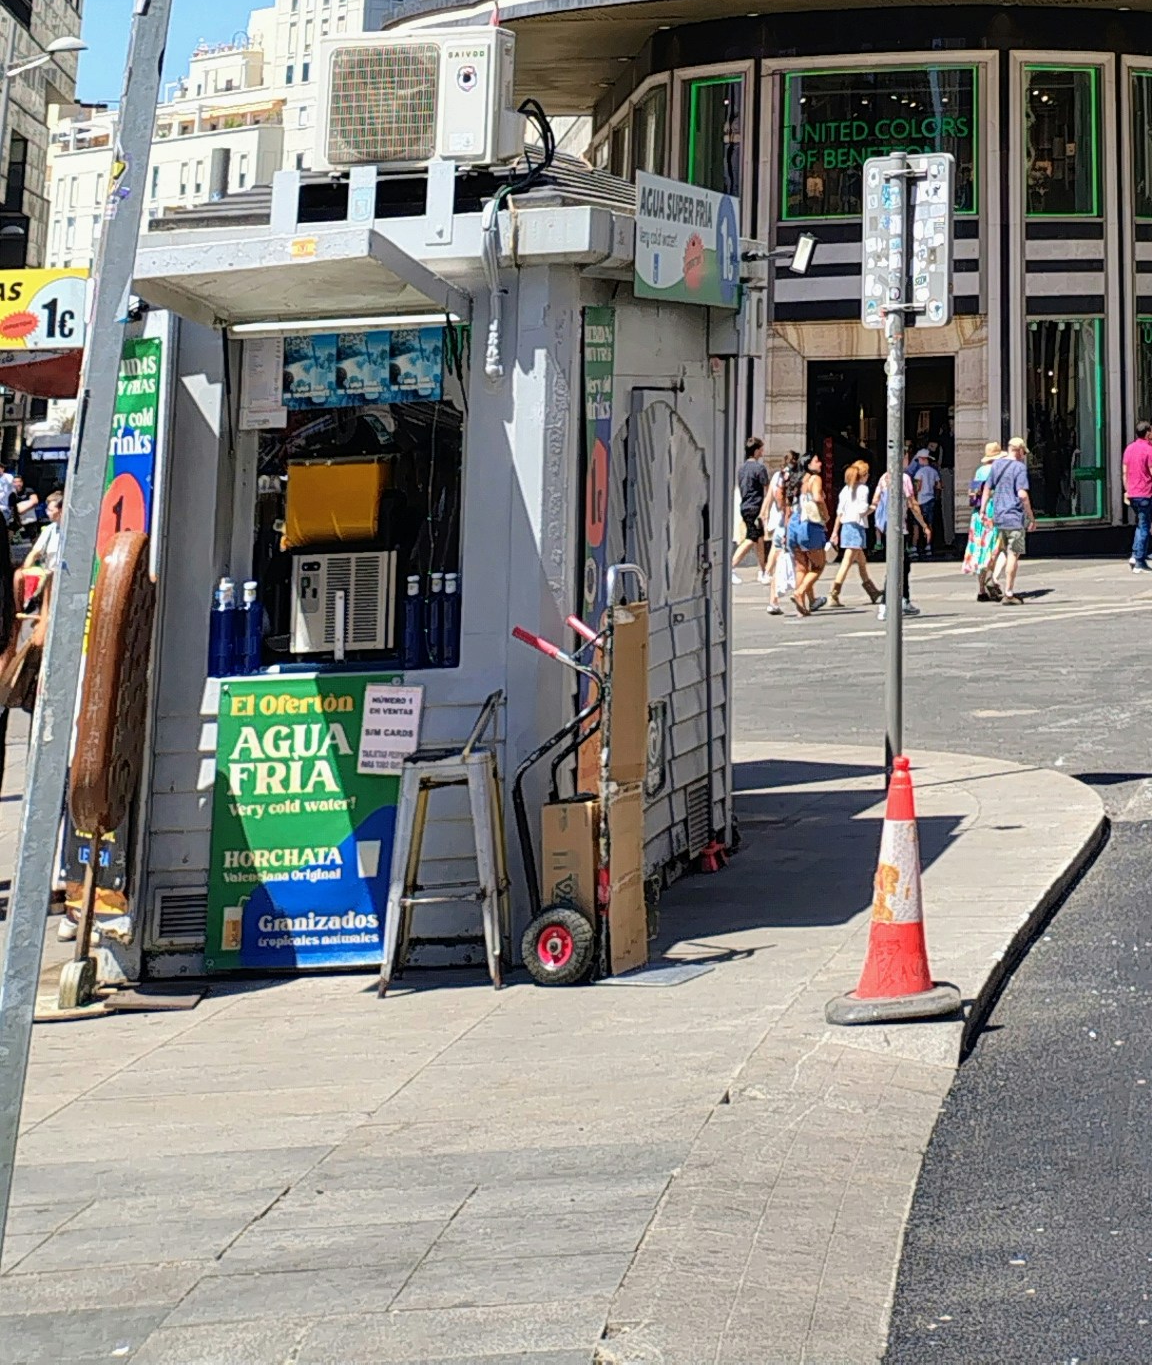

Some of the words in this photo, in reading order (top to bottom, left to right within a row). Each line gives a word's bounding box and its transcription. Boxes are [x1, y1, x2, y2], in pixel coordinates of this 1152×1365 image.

[791, 120, 869, 144] UNITED
[874, 116, 969, 140] COLORS
[789, 149, 819, 170] OF
[639, 186, 666, 220] AGUA
[666, 191, 694, 226] SUPER
[695, 192, 713, 229] FRÍA
[720, 215, 735, 282] 1€
[41, 297, 75, 339] 1€
[128, 407, 154, 428] cold
[109, 428, 152, 456] rinks
[230, 694, 255, 717] El
[258, 692, 355, 715] Ofertón
[228, 721, 354, 761] AGUA
[227, 753, 342, 796] FRÍA
[228, 801, 264, 819] Very
[268, 800, 301, 814] cold
[304, 796, 357, 812] water!
[223, 846, 344, 868] HORCHATA
[223, 871, 290, 883] Valenciana
[290, 867, 342, 883] Original
[257, 910, 379, 933] Granizados
[257, 935, 319, 949] tropicales
[321, 932, 379, 945] naturales
